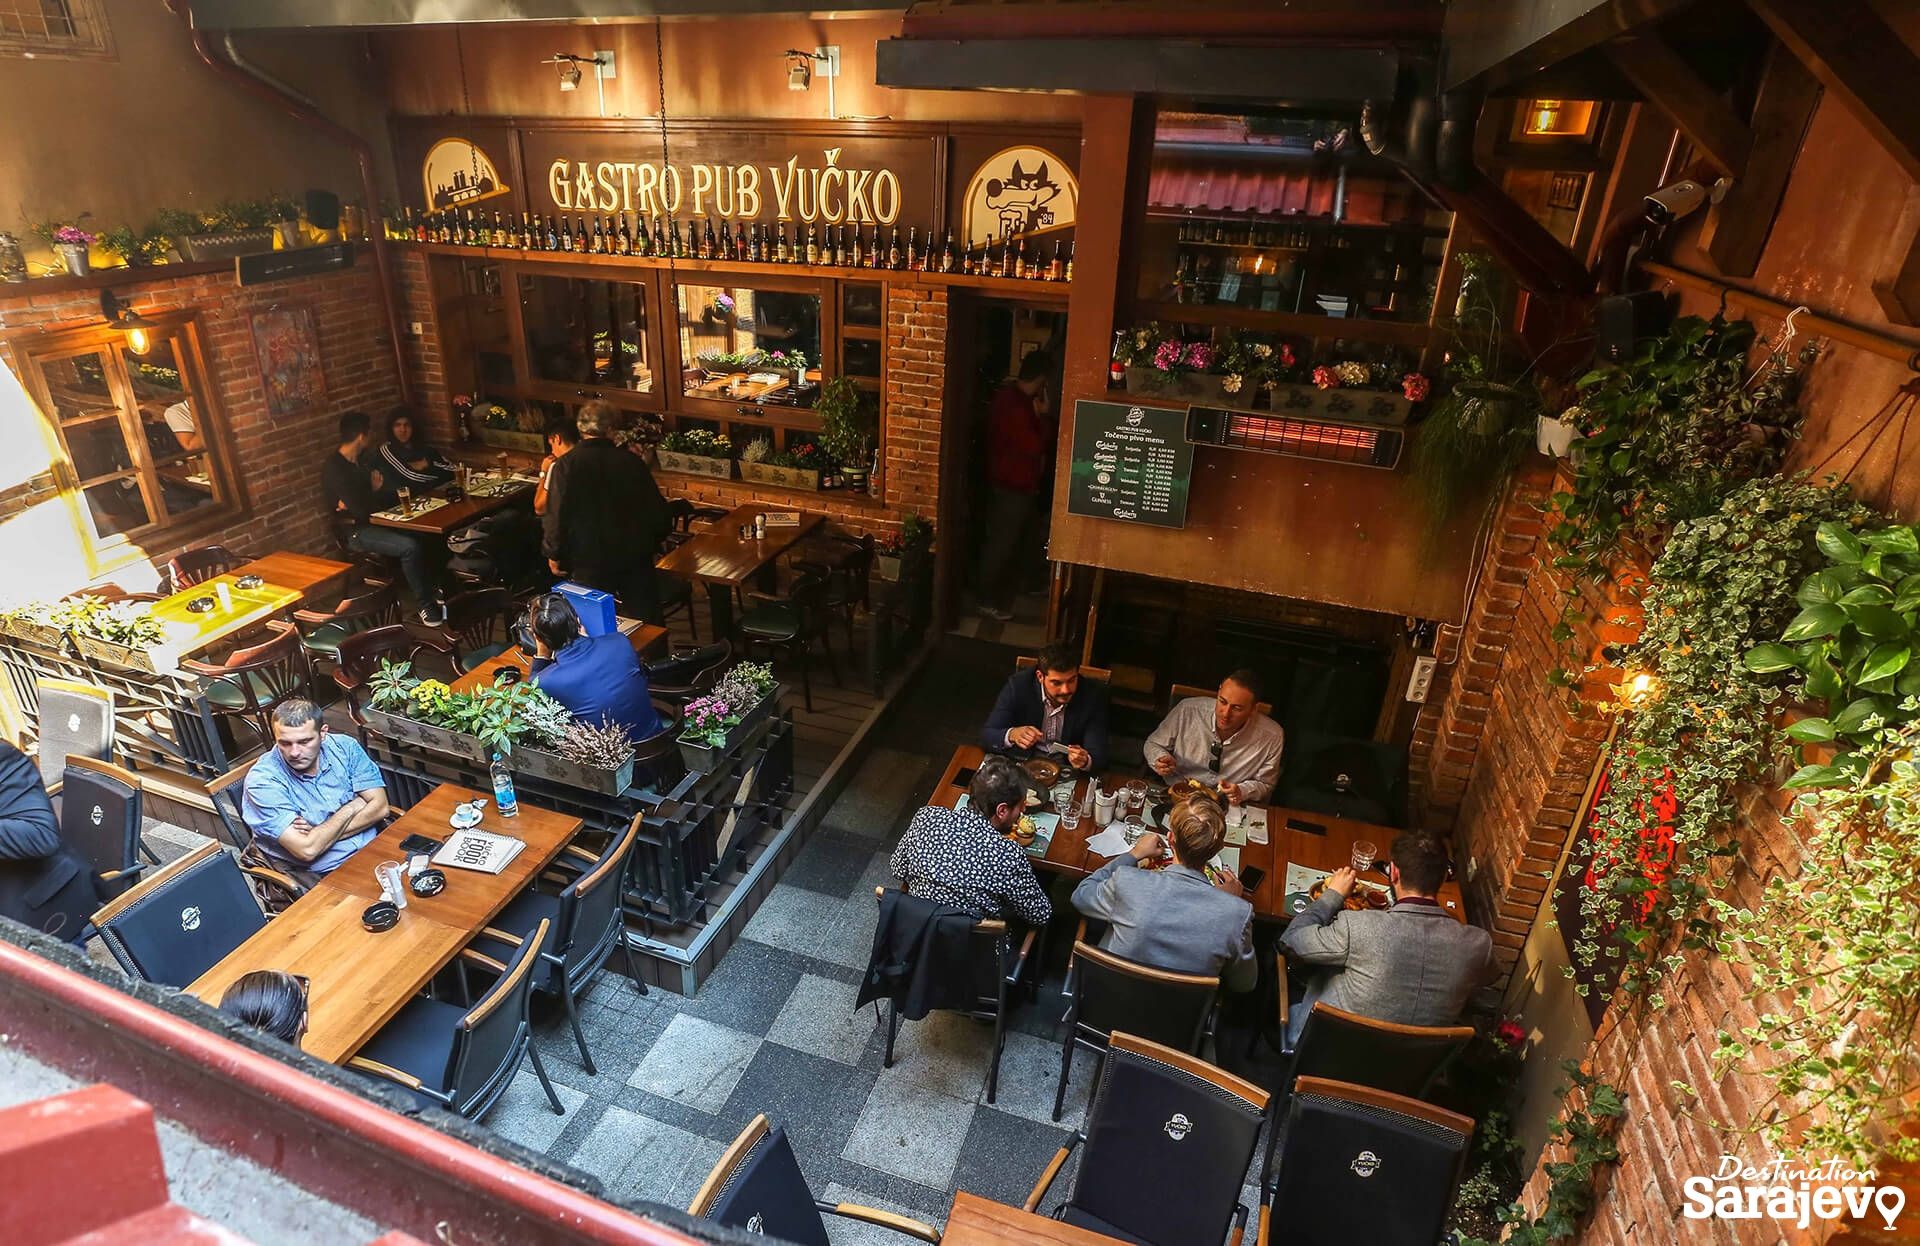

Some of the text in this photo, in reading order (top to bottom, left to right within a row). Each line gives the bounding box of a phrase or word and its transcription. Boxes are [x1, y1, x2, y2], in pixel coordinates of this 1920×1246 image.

[549, 147, 902, 226] GASTRO PUB VUČKO
[1104, 431, 1164, 445] Točeno pivo menu
[454, 837, 472, 862] BOOK
[463, 838, 487, 865] FOOD
